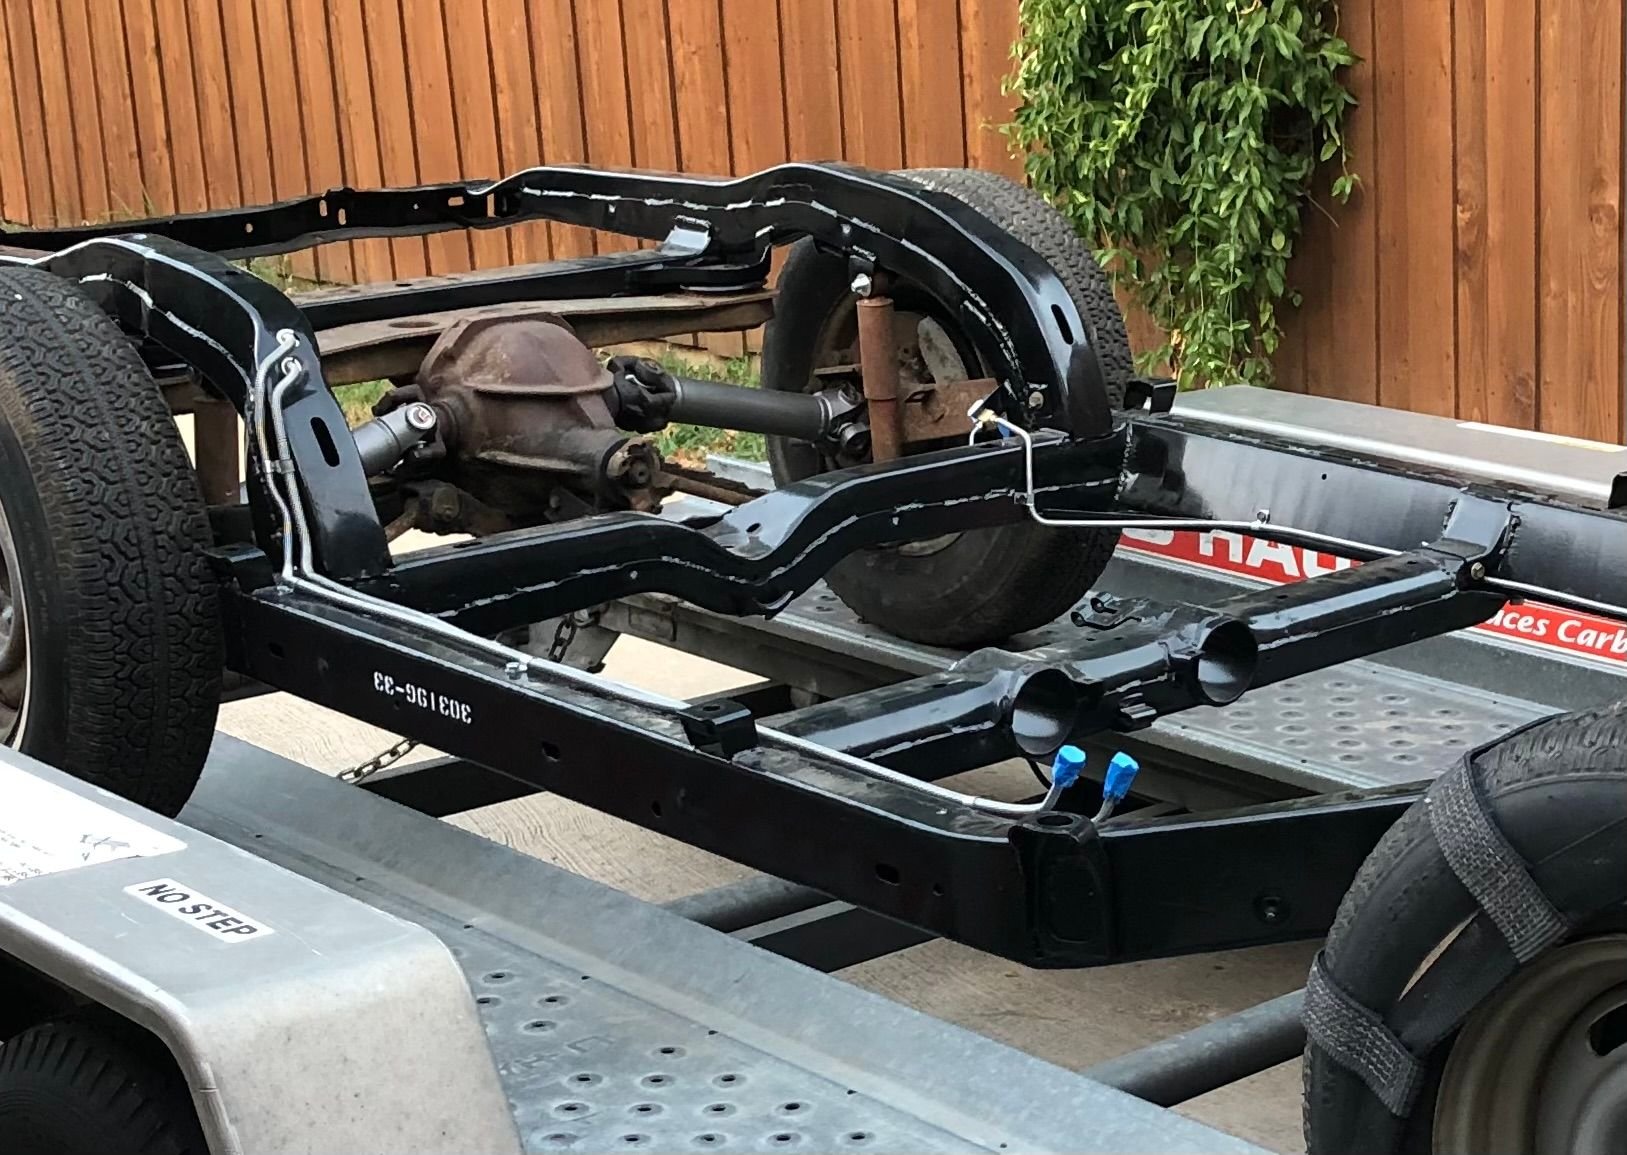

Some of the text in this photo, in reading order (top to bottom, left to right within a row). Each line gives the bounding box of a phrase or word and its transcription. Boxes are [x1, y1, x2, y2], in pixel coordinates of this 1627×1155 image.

[373, 671, 472, 724] 303196-33
[138, 884, 258, 935] NO STEP
